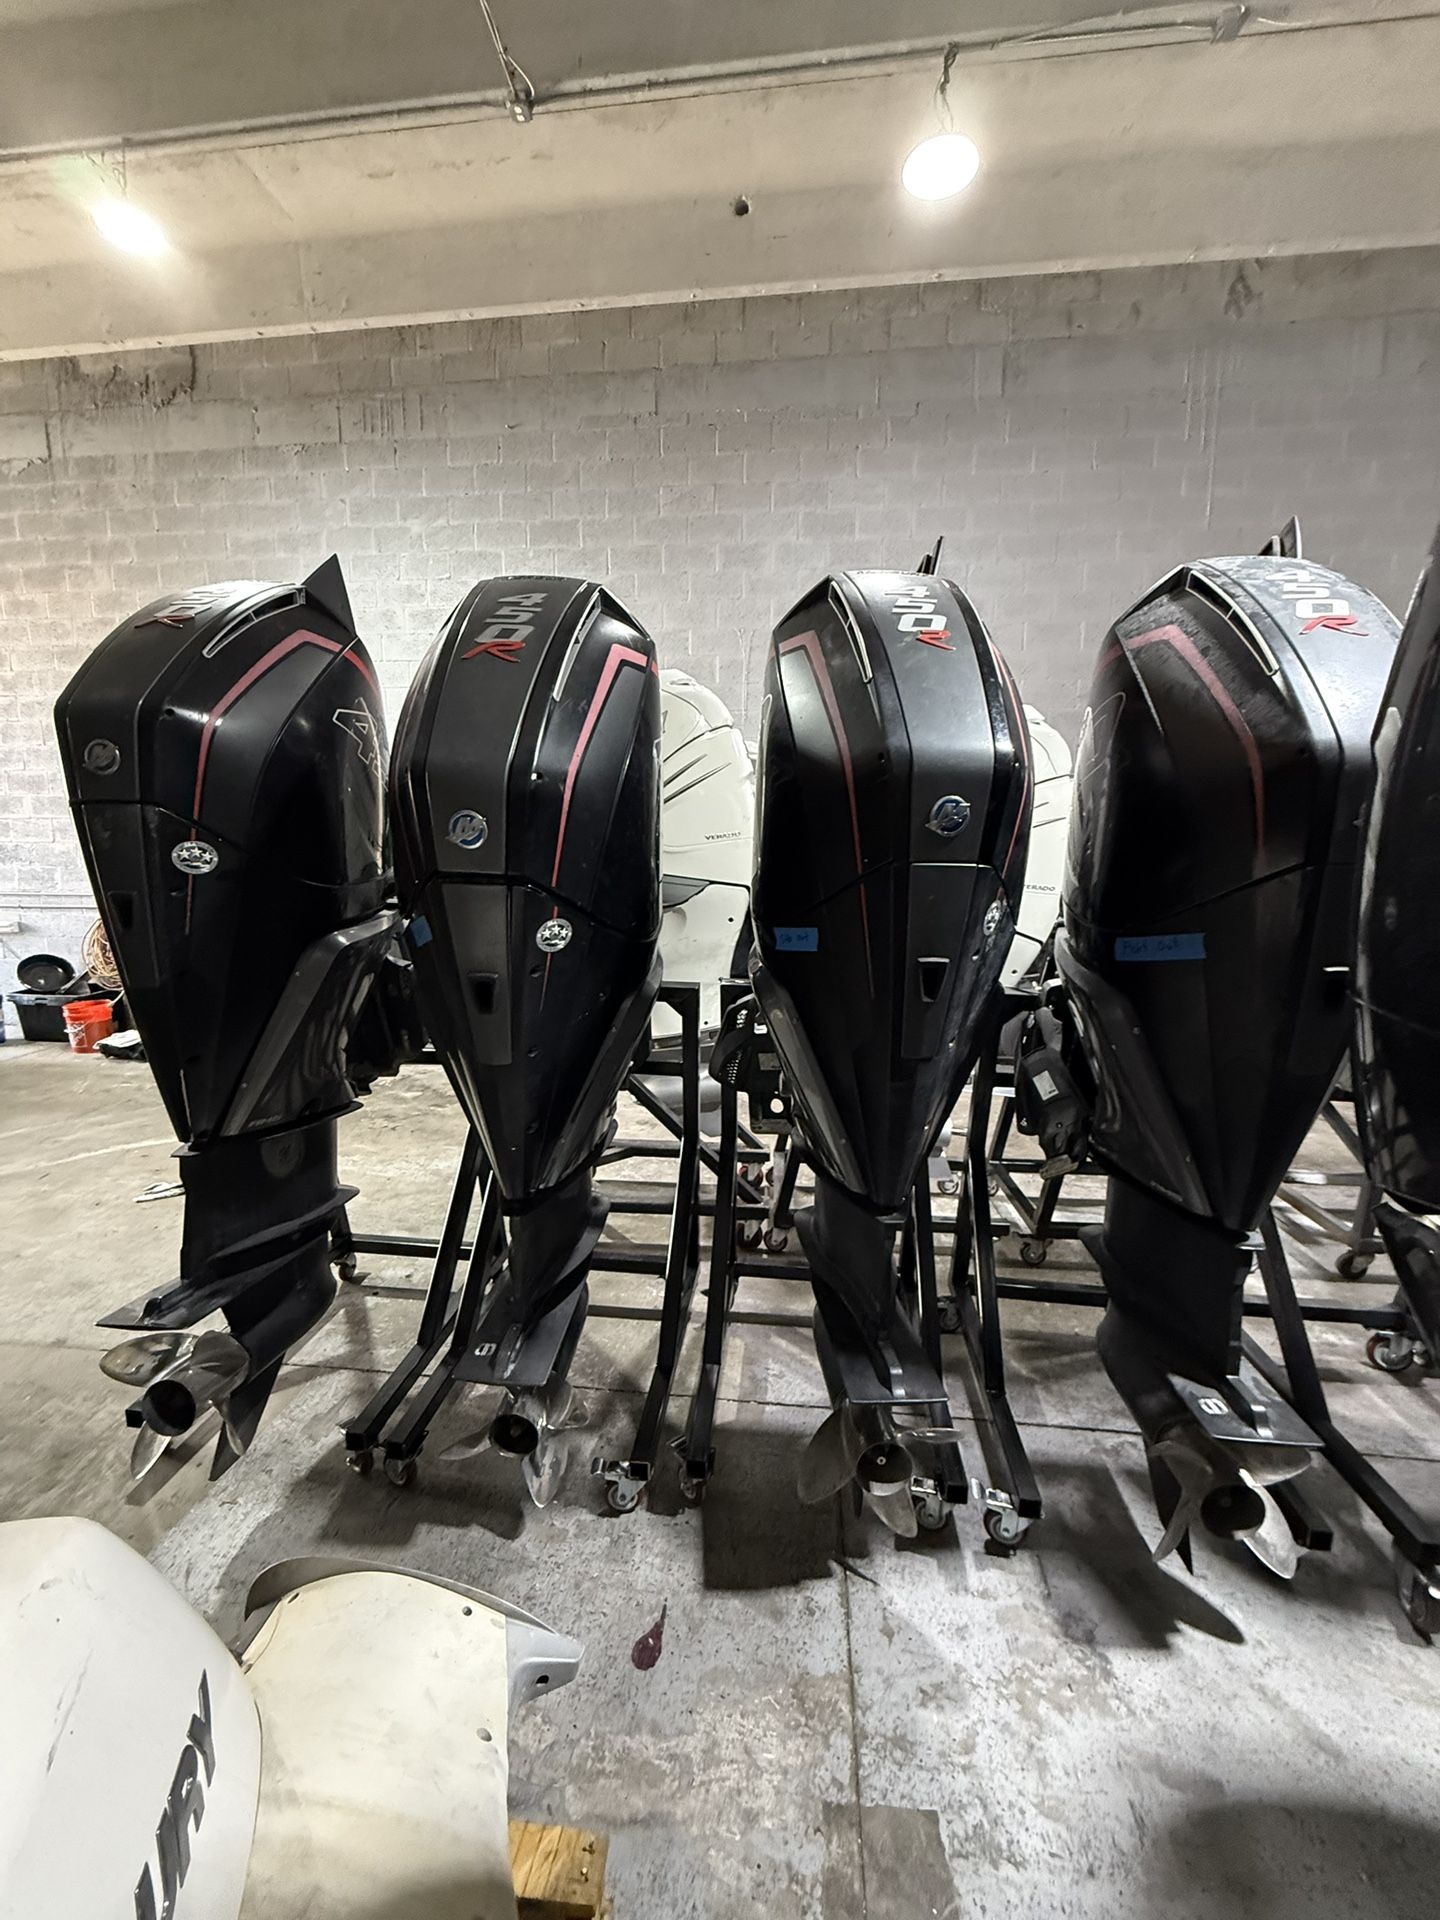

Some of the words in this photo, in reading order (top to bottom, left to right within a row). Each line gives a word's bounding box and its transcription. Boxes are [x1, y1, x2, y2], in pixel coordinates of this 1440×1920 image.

[461, 593, 549, 663] 450R
[882, 585, 957, 650] 450R
[1264, 569, 1369, 636] 450R
